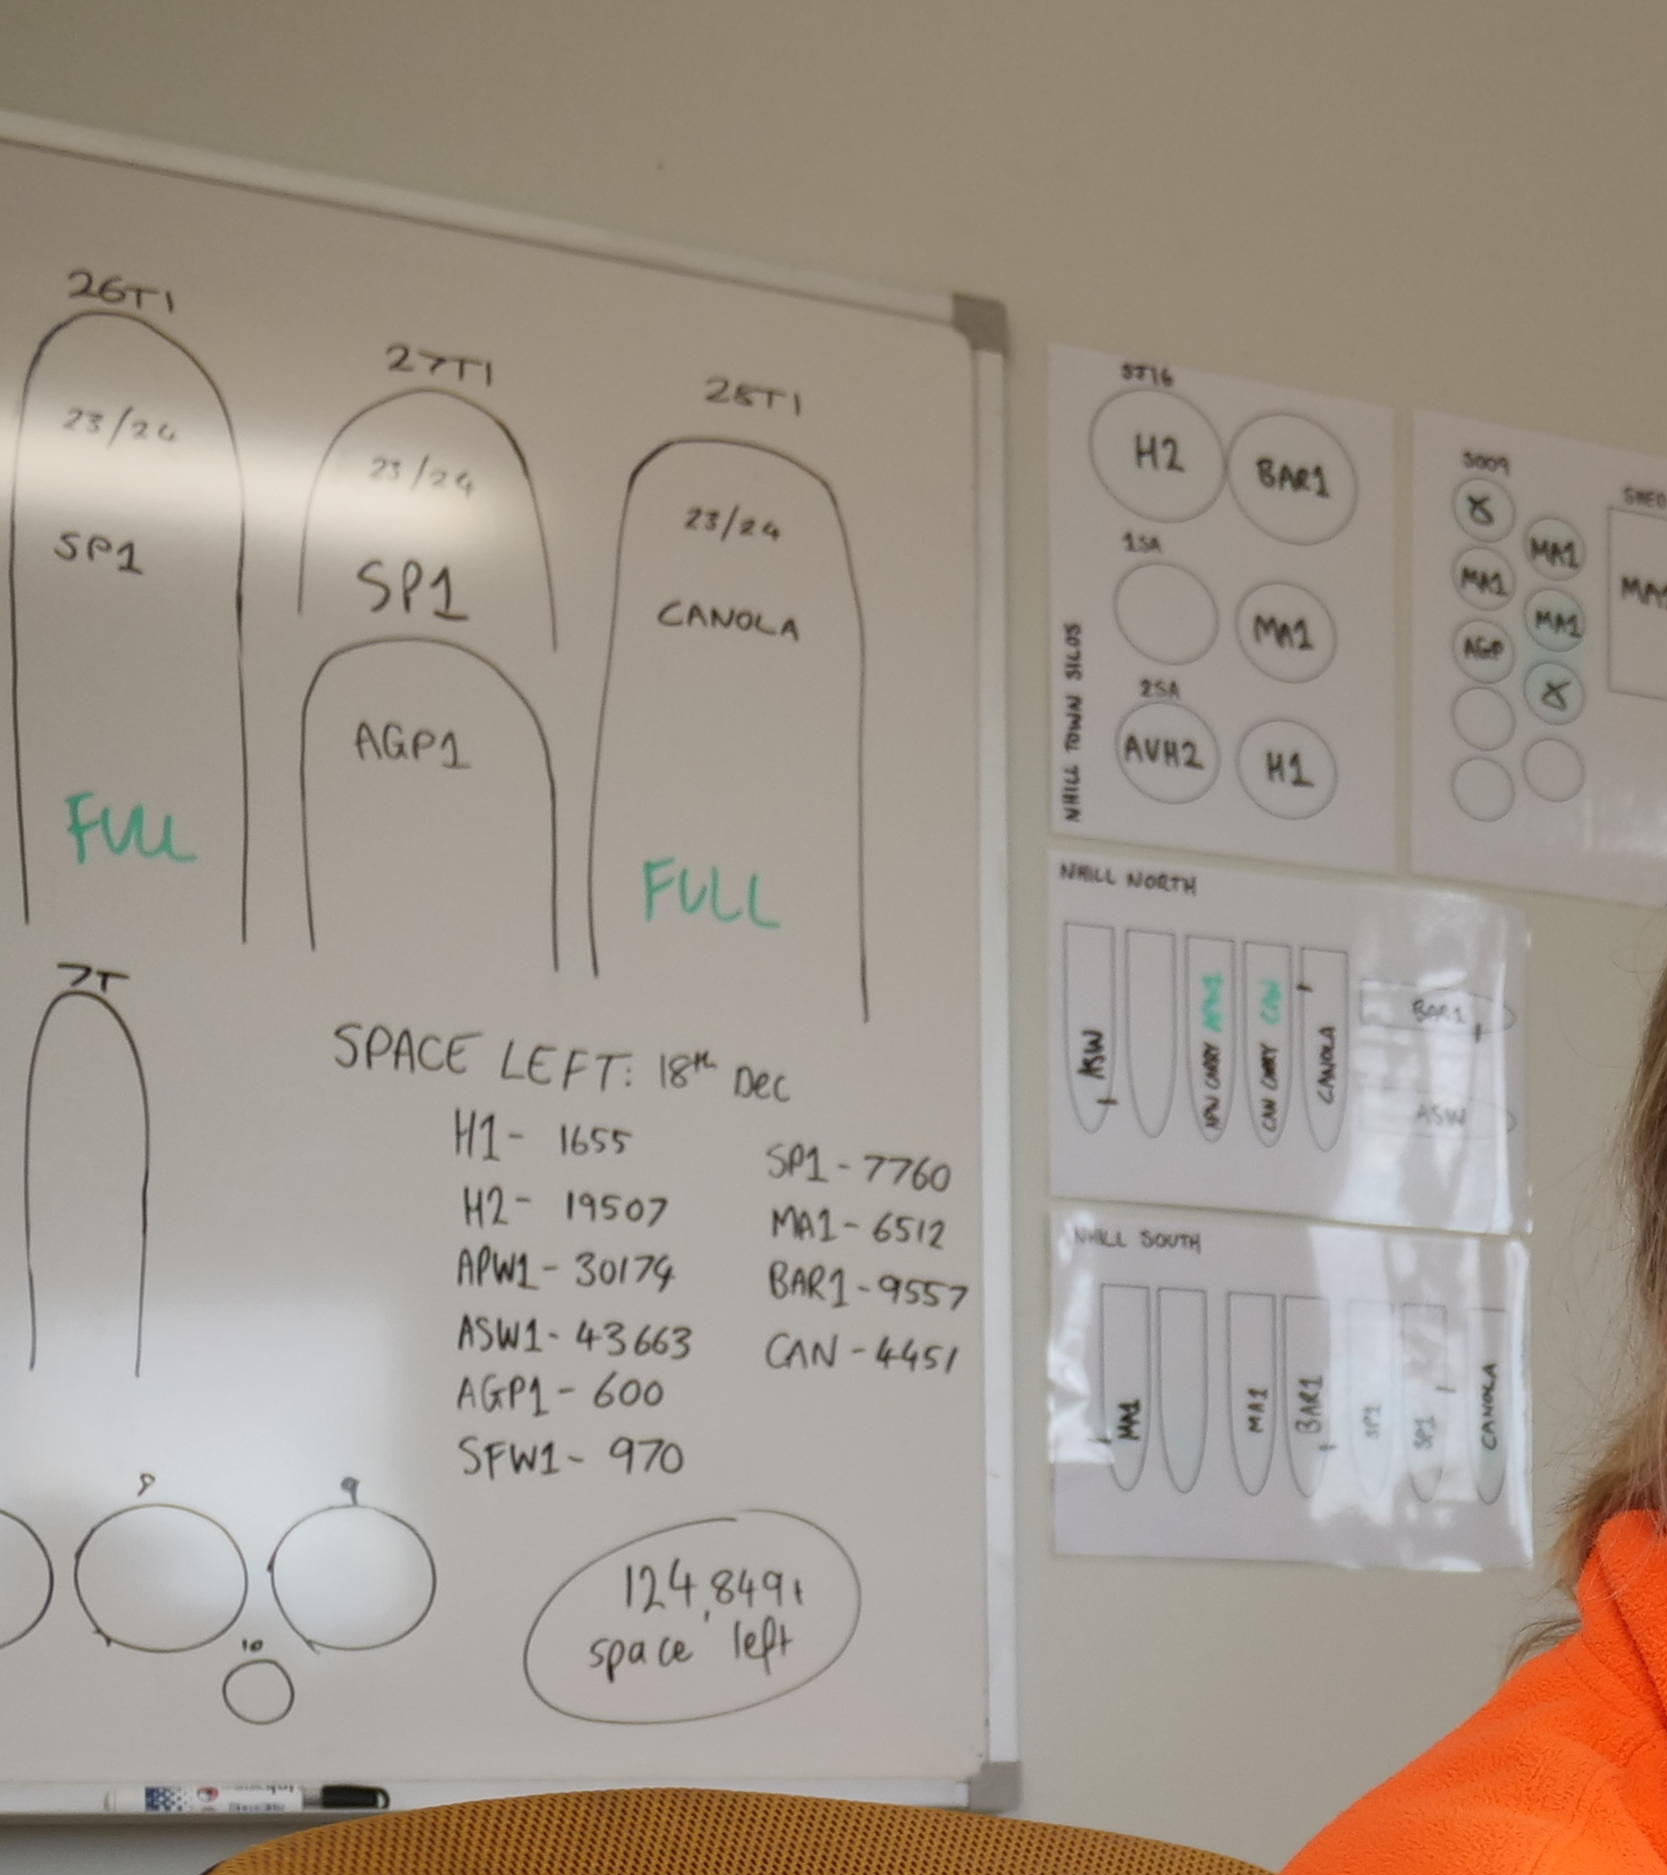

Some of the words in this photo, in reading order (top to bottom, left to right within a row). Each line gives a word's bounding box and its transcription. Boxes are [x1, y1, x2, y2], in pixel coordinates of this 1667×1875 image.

[68, 270, 175, 312] 26T1
[385, 344, 494, 387] 27T1
[62, 406, 178, 447] 23/24
[1135, 433, 1185, 472] H2
[1256, 457, 1331, 500] BAR1
[684, 504, 782, 544] 23/24
[54, 531, 144, 576] SP1
[358, 557, 469, 622] SP1
[657, 600, 800, 643] CANOLA
[1253, 611, 1316, 652] MA1
[1064, 621, 1083, 681] SILOS
[1064, 693, 1083, 756] TOWN
[354, 722, 472, 770] AGP1
[1265, 750, 1315, 788] H1
[1064, 761, 1082, 823] NHILL
[65, 791, 198, 864] FULL
[642, 857, 780, 929] FULL
[1059, 861, 1120, 889] NHILL
[1126, 869, 1199, 898] NORTH
[332, 1021, 483, 1078] SPACE
[499, 1039, 634, 1095] LEFT:
[558, 1122, 634, 1158] 1655
[565, 1189, 670, 1229] 19507
[1140, 1228, 1202, 1254] SOUTH
[575, 1320, 695, 1361] 43663
[593, 1376, 665, 1411] 600
[608, 1436, 685, 1477] 970
[588, 1627, 695, 1684] space
[732, 1617, 795, 1678] left
